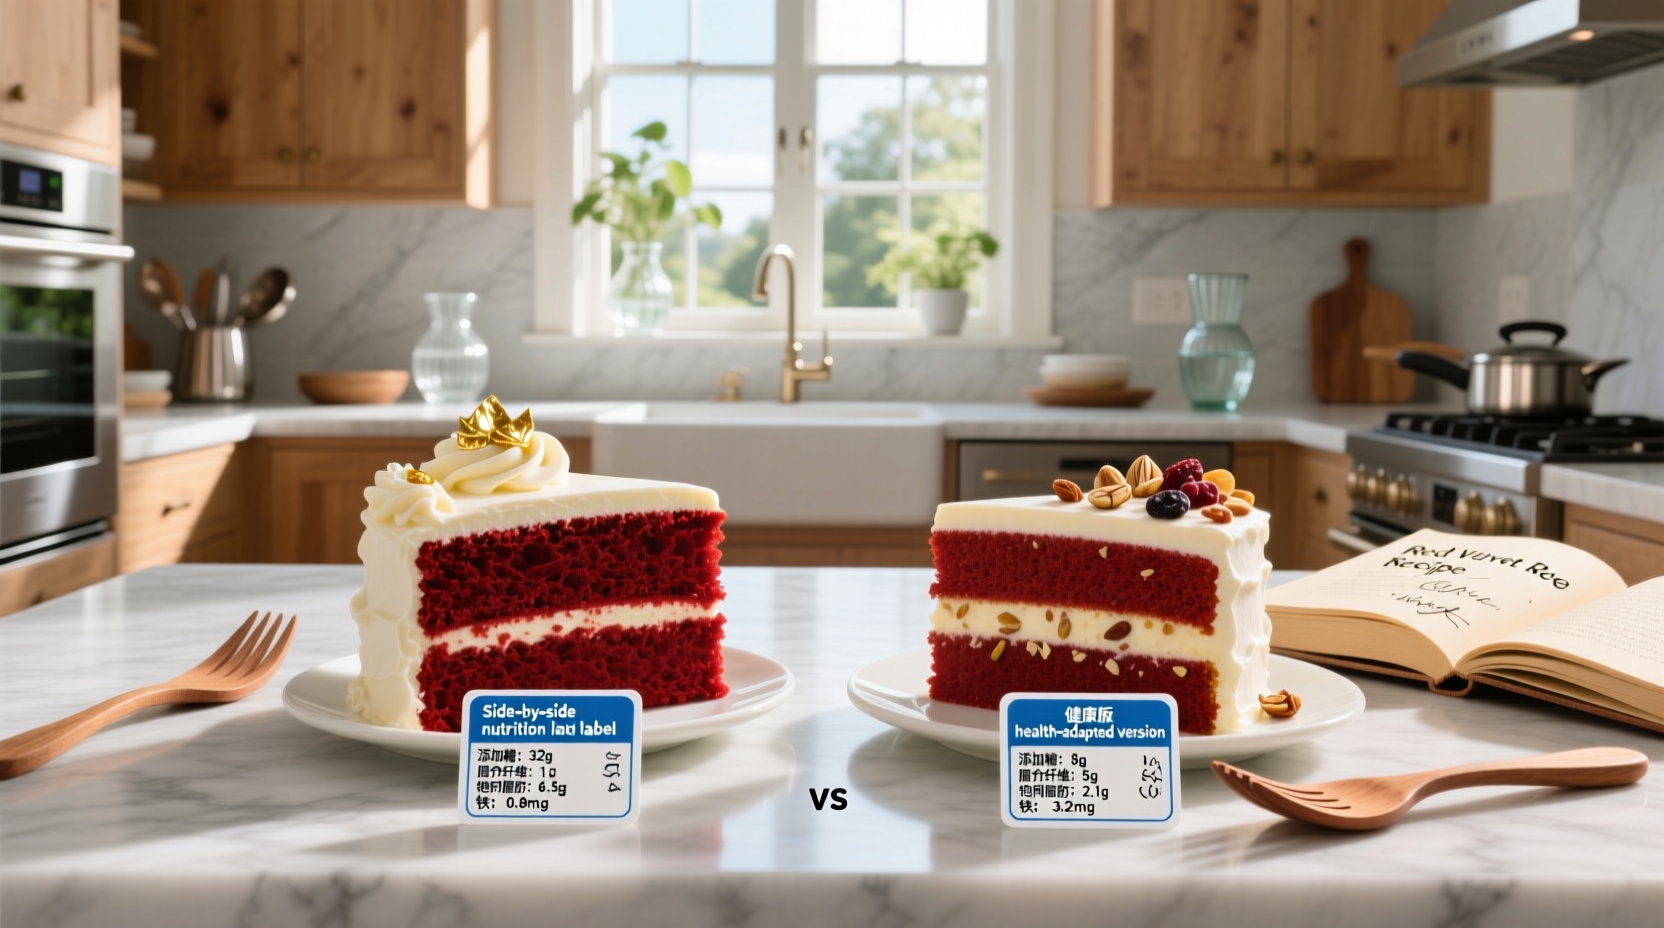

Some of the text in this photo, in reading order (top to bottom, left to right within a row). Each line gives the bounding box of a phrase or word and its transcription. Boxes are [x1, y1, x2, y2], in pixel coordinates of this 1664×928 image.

[482, 703, 576, 721] Side-by-side
[481, 721, 546, 736] nutrition
[580, 720, 617, 736] label
[1015, 723, 1166, 742] health-adapted version
[528, 749, 553, 764] 32g
[1071, 753, 1087, 768] 8g
[1082, 769, 1098, 784] 5g
[538, 781, 567, 797] 6.5g
[1082, 785, 1109, 801] 2.1g
[1052, 801, 1095, 816] 3.2mg
